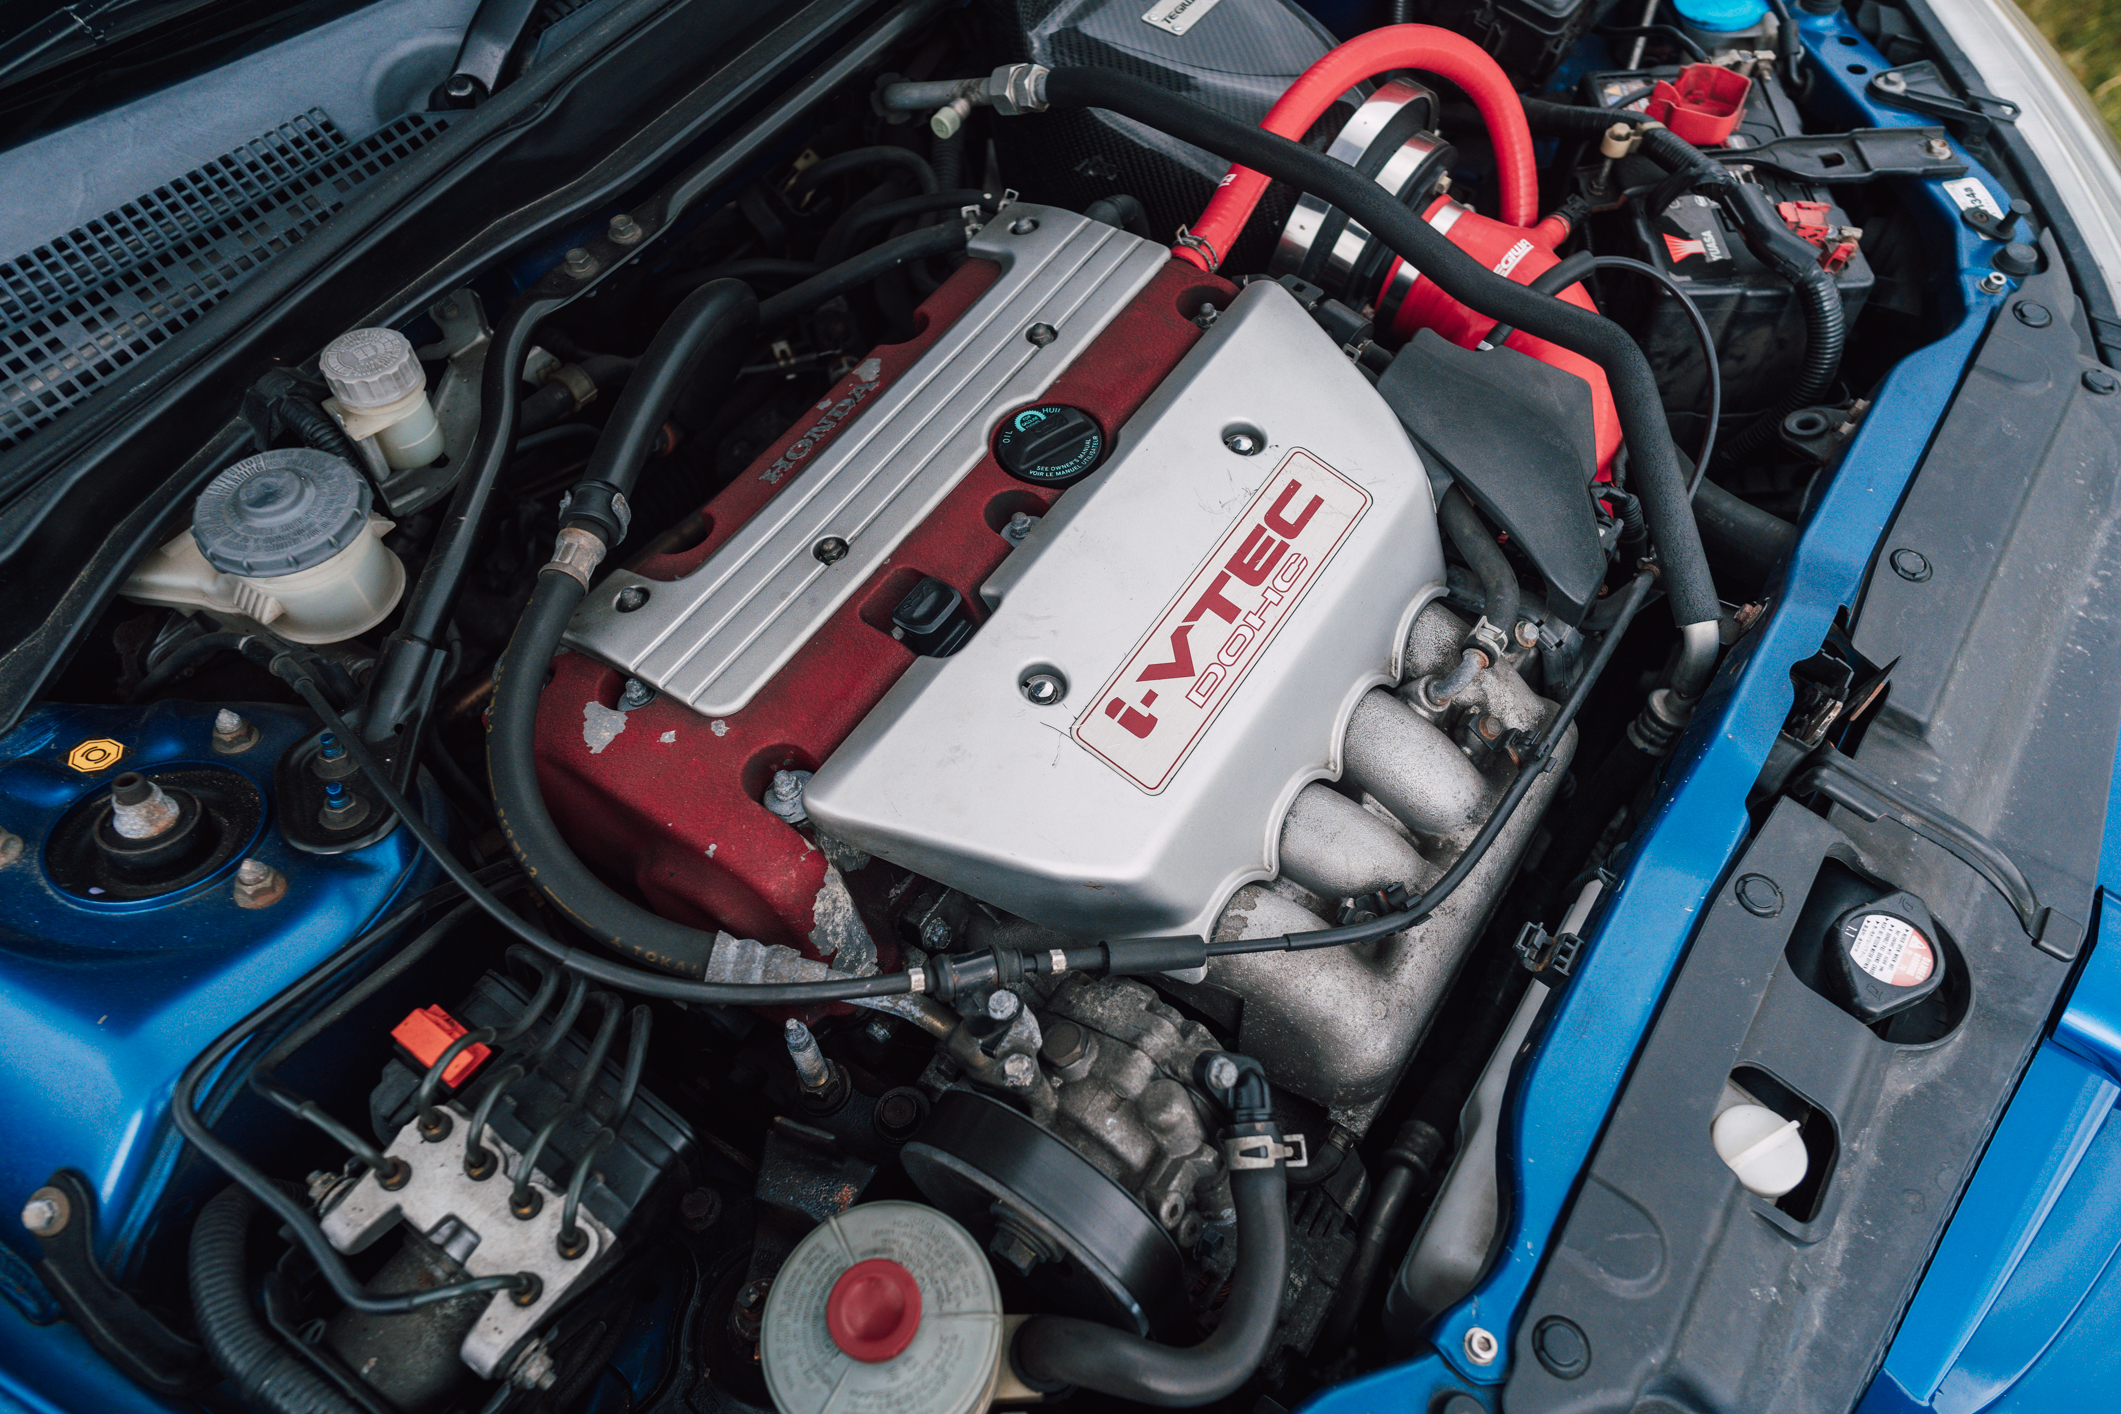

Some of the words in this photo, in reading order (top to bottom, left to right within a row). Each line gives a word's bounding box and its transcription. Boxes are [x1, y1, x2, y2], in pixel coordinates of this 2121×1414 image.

[1493, 238, 1534, 277] EGIWA
[1701, 230, 1723, 261] YUASA
[758, 381, 881, 484] HONDA
[1002, 430, 1013, 444] OIL
[1029, 469, 1044, 477] VOIR
[1055, 464, 1082, 477] MANUEL
[1081, 435, 1099, 465] UTILISATEUR
[1050, 457, 1080, 472] OWNER'S
[1077, 438, 1091, 459] MANUAL
[1105, 479, 1325, 739] i-VTEC
[1185, 552, 1309, 709] DOHC
